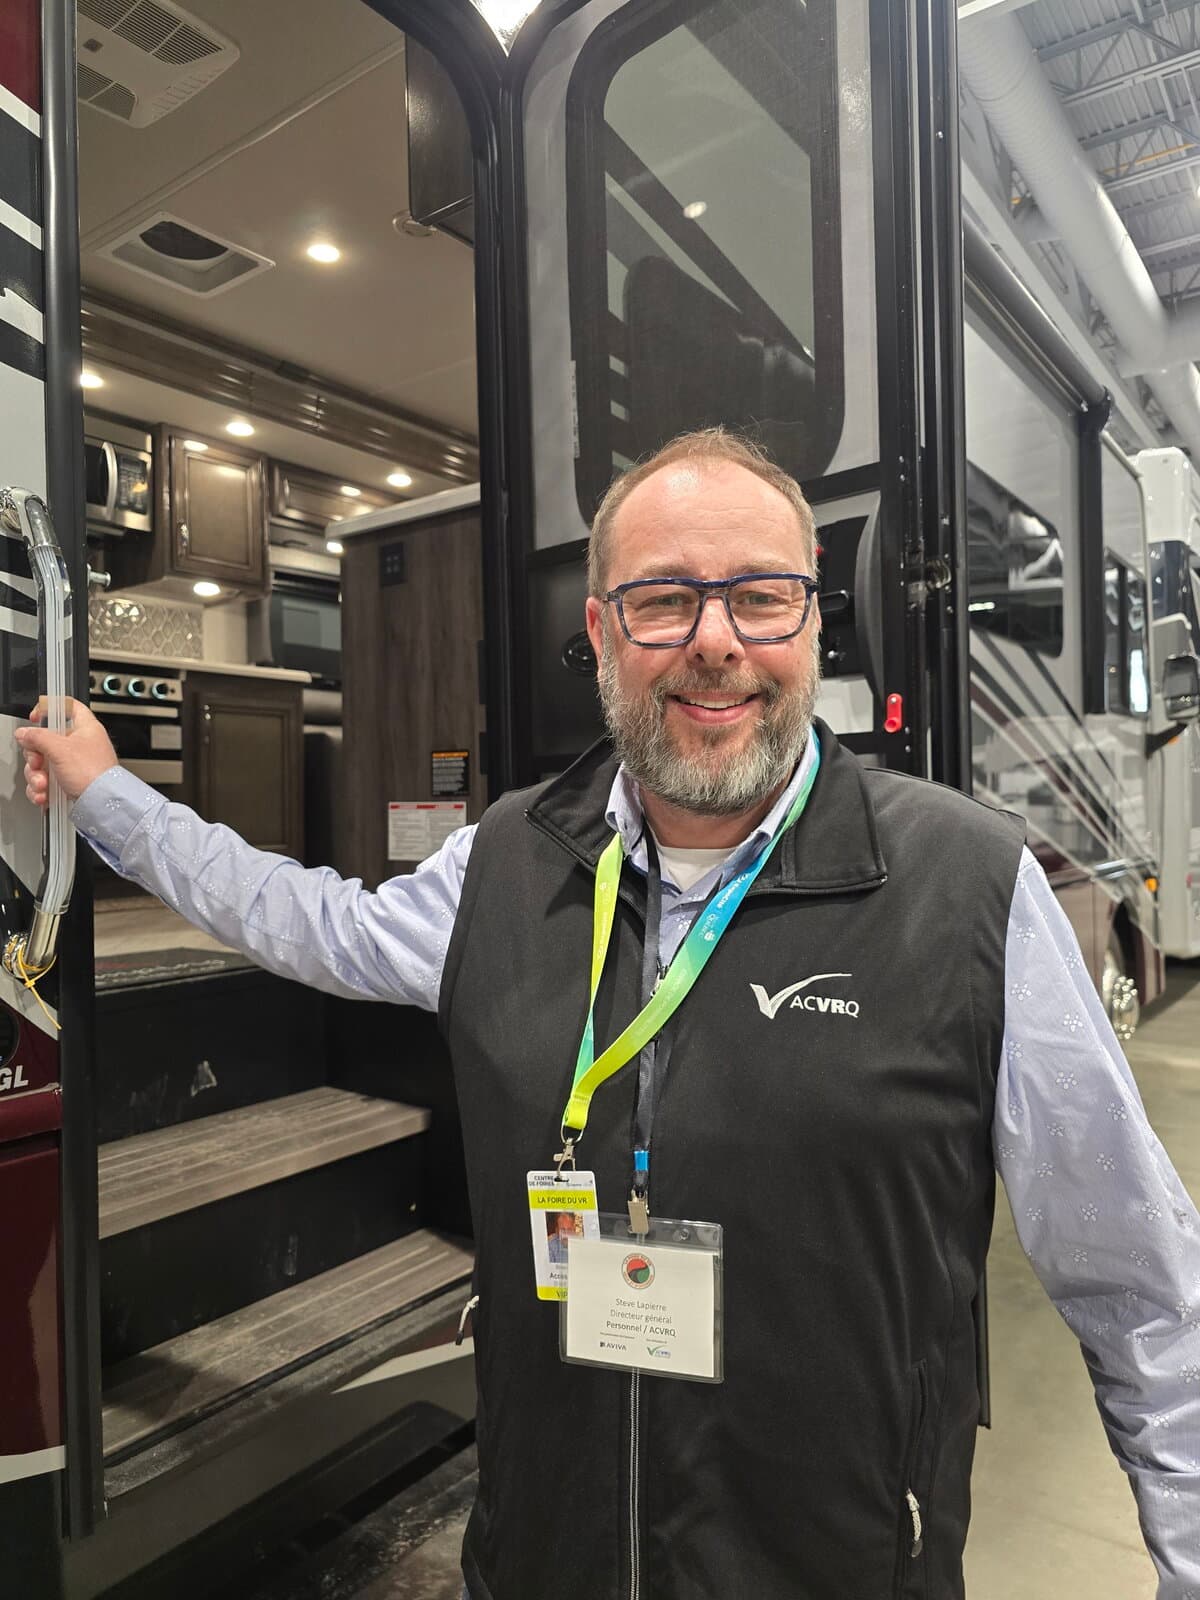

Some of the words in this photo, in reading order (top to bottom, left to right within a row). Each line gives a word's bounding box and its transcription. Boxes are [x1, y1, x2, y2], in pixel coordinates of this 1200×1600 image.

[789, 995, 860, 1018] ACVRQ
[537, 1196, 546, 1204] LA
[547, 1196, 566, 1204] FOIRE
[567, 1196, 577, 1204] DU
[615, 1298, 635, 1308] Steve
[637, 1300, 667, 1311] Lapierre
[610, 1309, 643, 1321] Directeur
[644, 1313, 672, 1324] général
[606, 1320, 642, 1332] Personnel
[649, 1325, 677, 1338] ACVRQ
[606, 1342, 627, 1351] AVIVA
